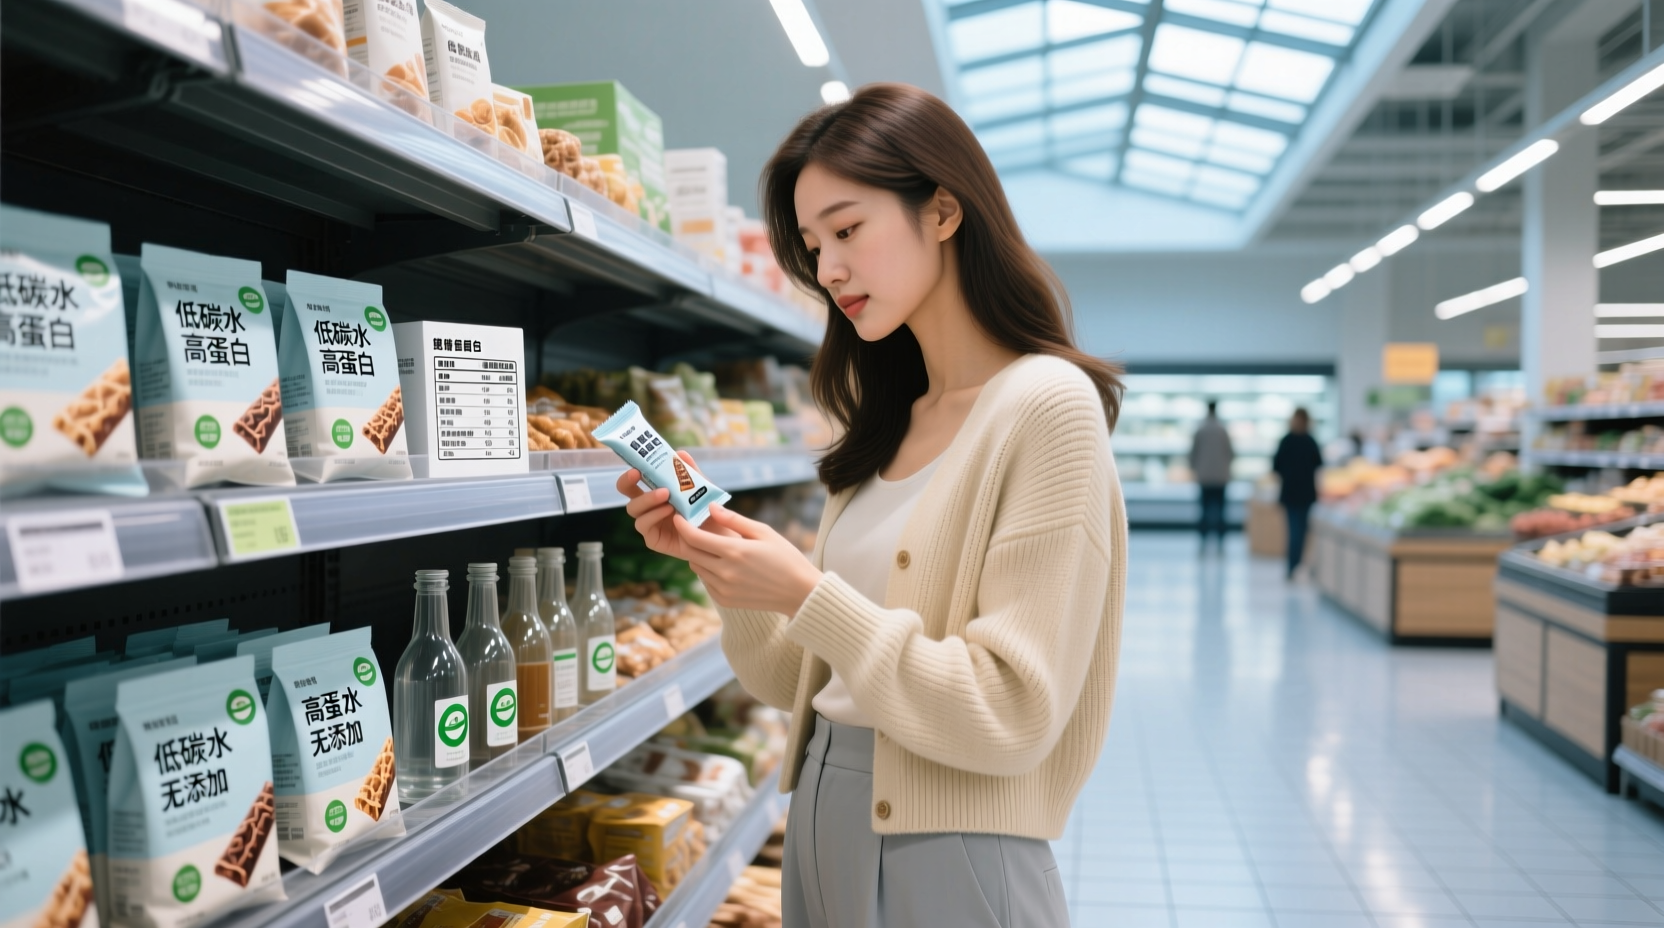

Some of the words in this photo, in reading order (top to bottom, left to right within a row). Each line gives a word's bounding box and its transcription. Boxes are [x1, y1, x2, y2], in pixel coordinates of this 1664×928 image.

[175, 299, 246, 334] 低碳水
[314, 320, 371, 348] 低碳水
[181, 333, 251, 366] 高蛋白
[319, 348, 375, 377] 高蛋白
[301, 686, 363, 726] 高蛋水
[154, 727, 233, 776] 低碳水
[310, 720, 363, 757] 无添加
[160, 768, 229, 812] 无添加
